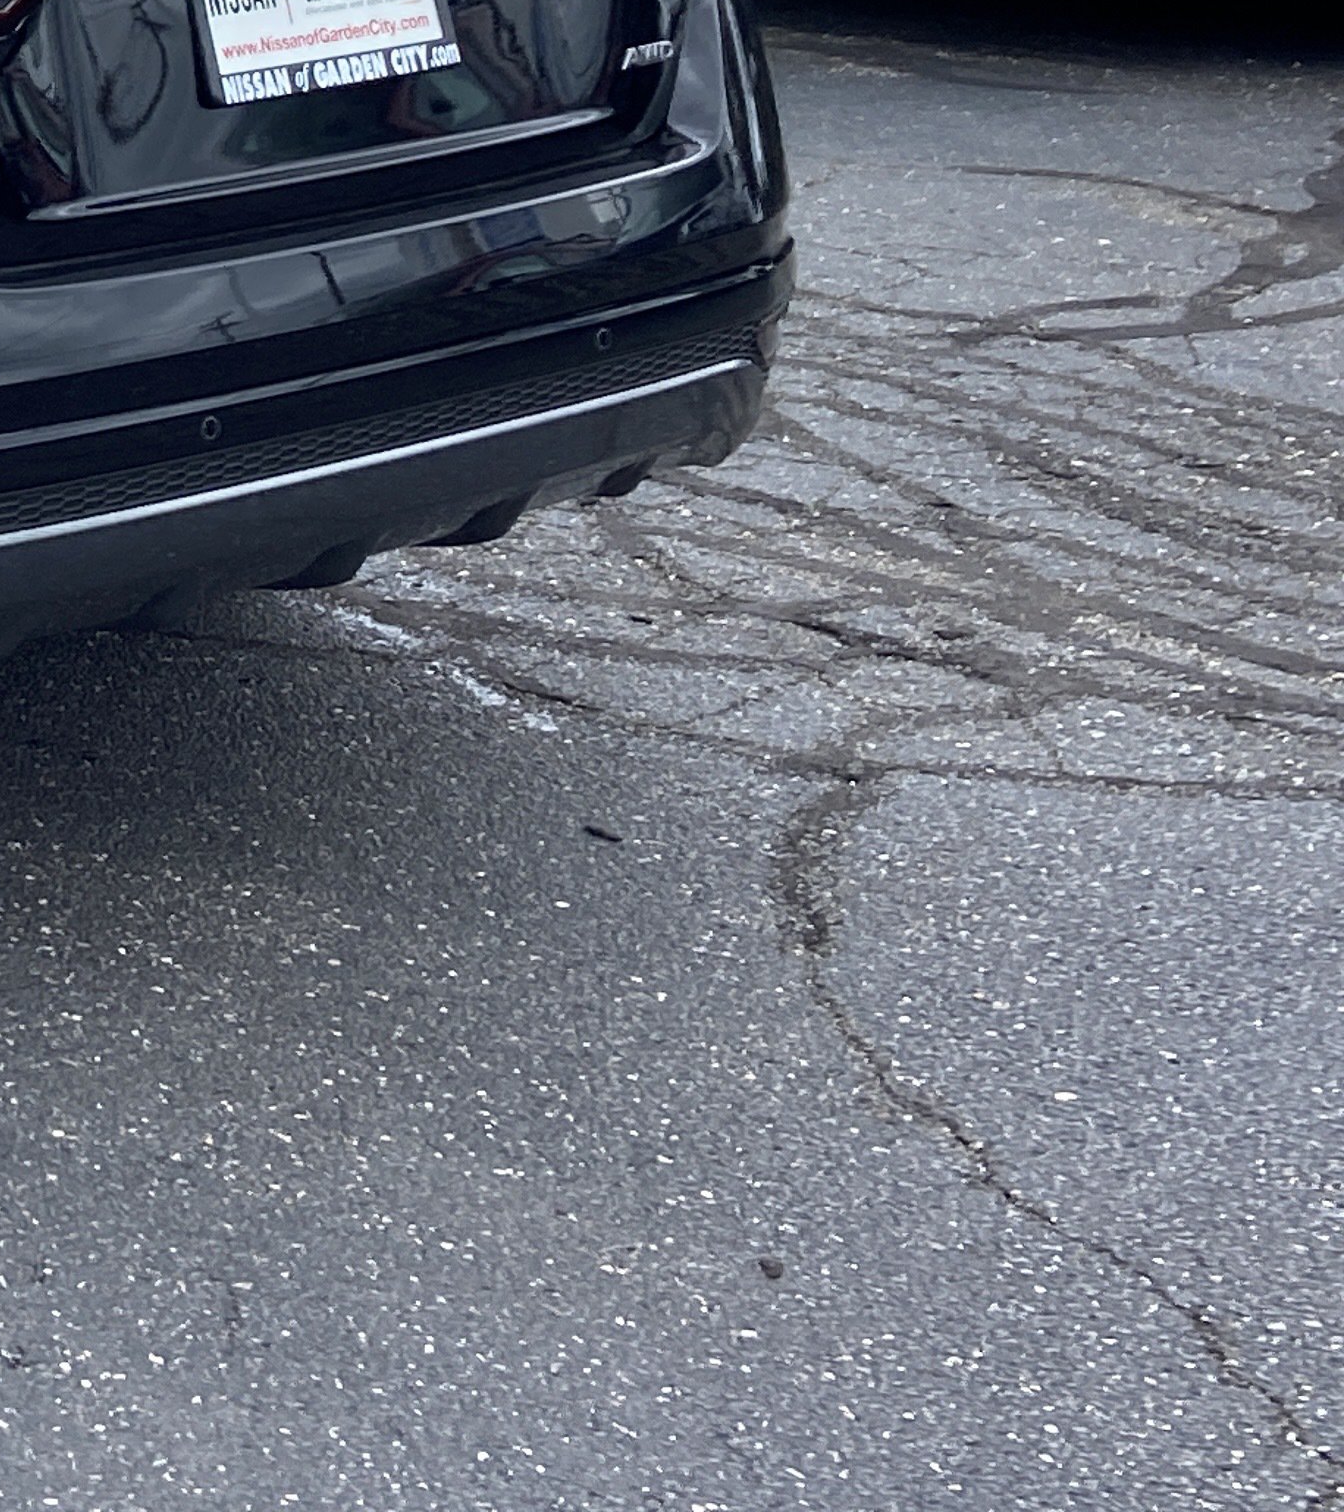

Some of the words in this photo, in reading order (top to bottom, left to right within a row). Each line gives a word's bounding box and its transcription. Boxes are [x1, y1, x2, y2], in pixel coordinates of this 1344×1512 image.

[221, 14, 430, 59] www.NissanofGardenCity.com
[221, 67, 291, 105] NISSAN
[295, 63, 310, 93] of
[314, 51, 388, 88] GARDEN
